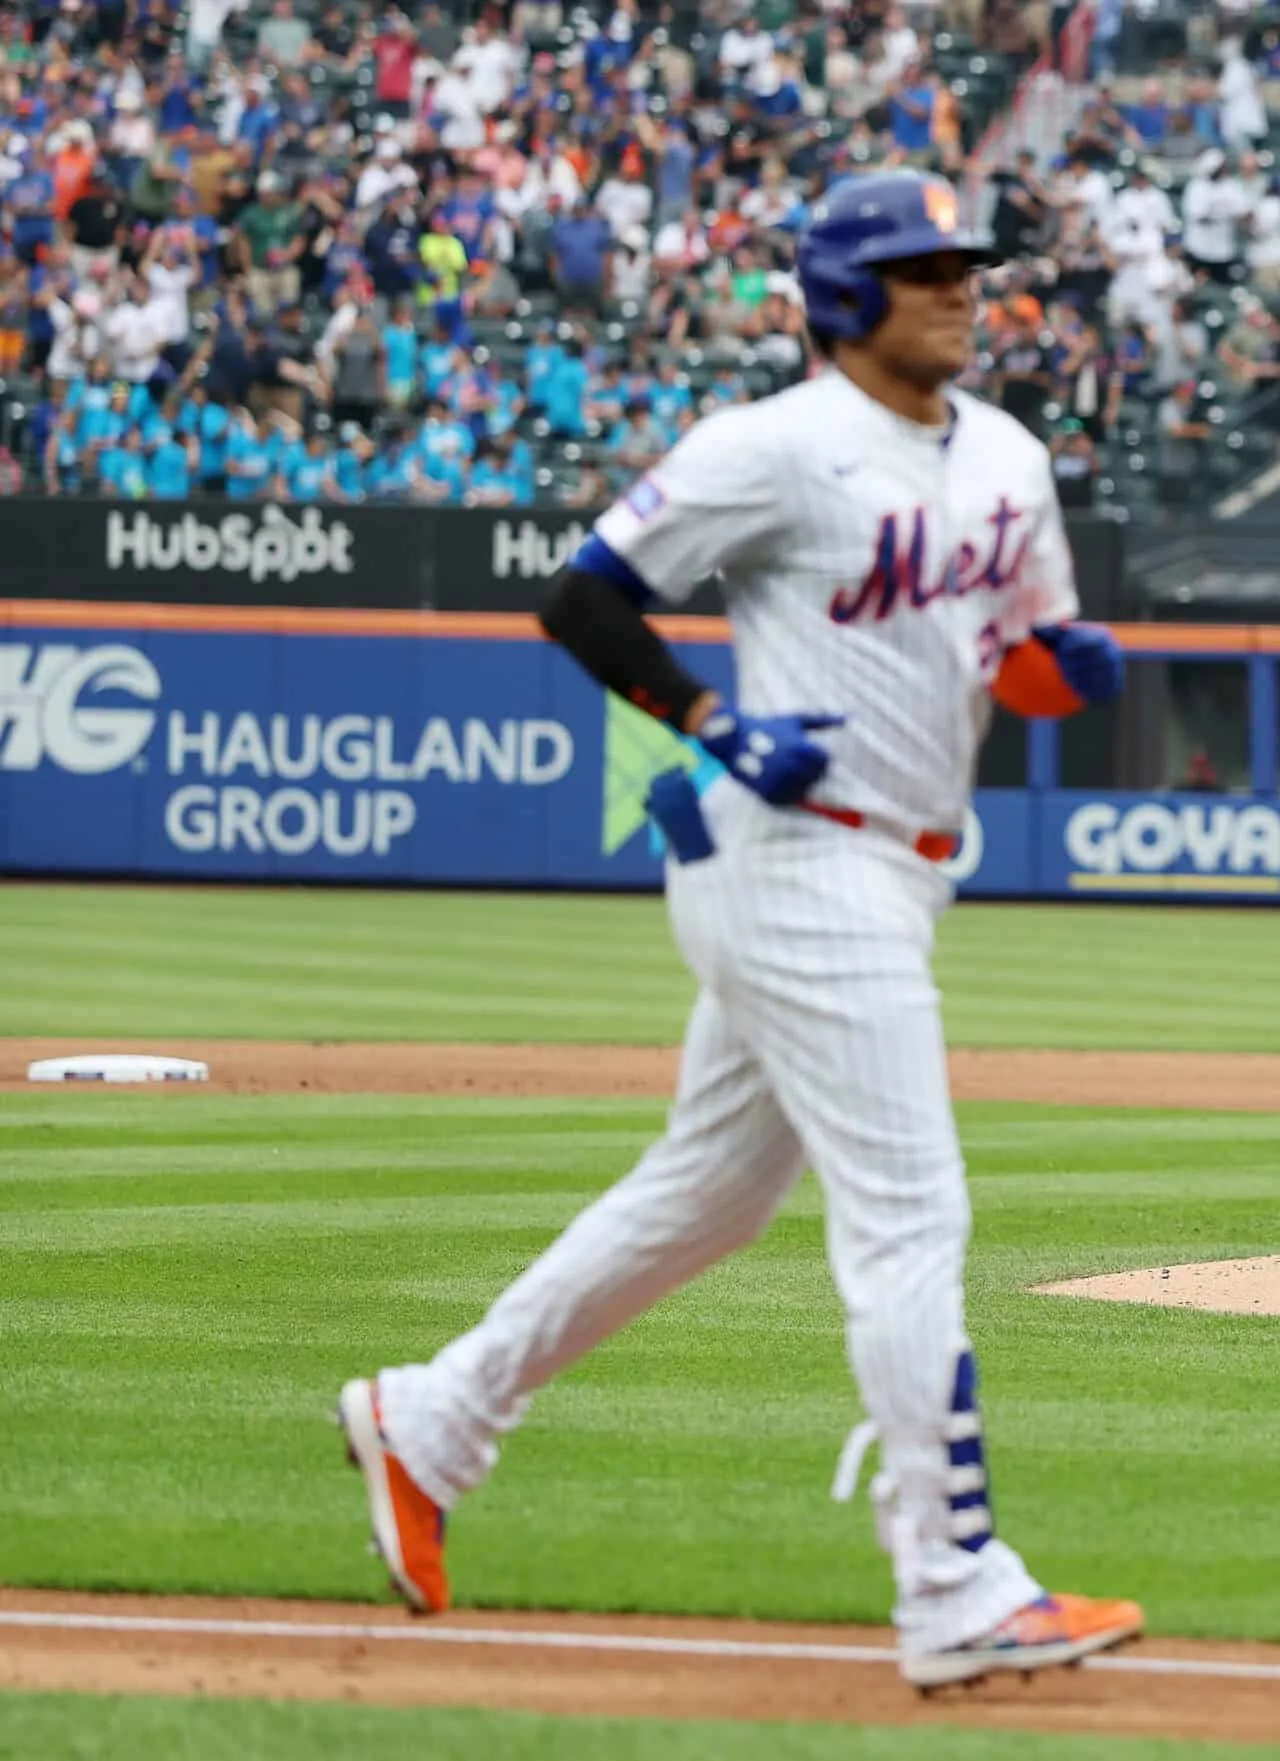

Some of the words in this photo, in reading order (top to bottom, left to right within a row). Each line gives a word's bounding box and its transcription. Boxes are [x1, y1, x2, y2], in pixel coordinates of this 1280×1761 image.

[106, 502, 354, 583] HubSpot
[167, 709, 575, 785] HAUGLAND
[164, 784, 417, 856] GROUP
